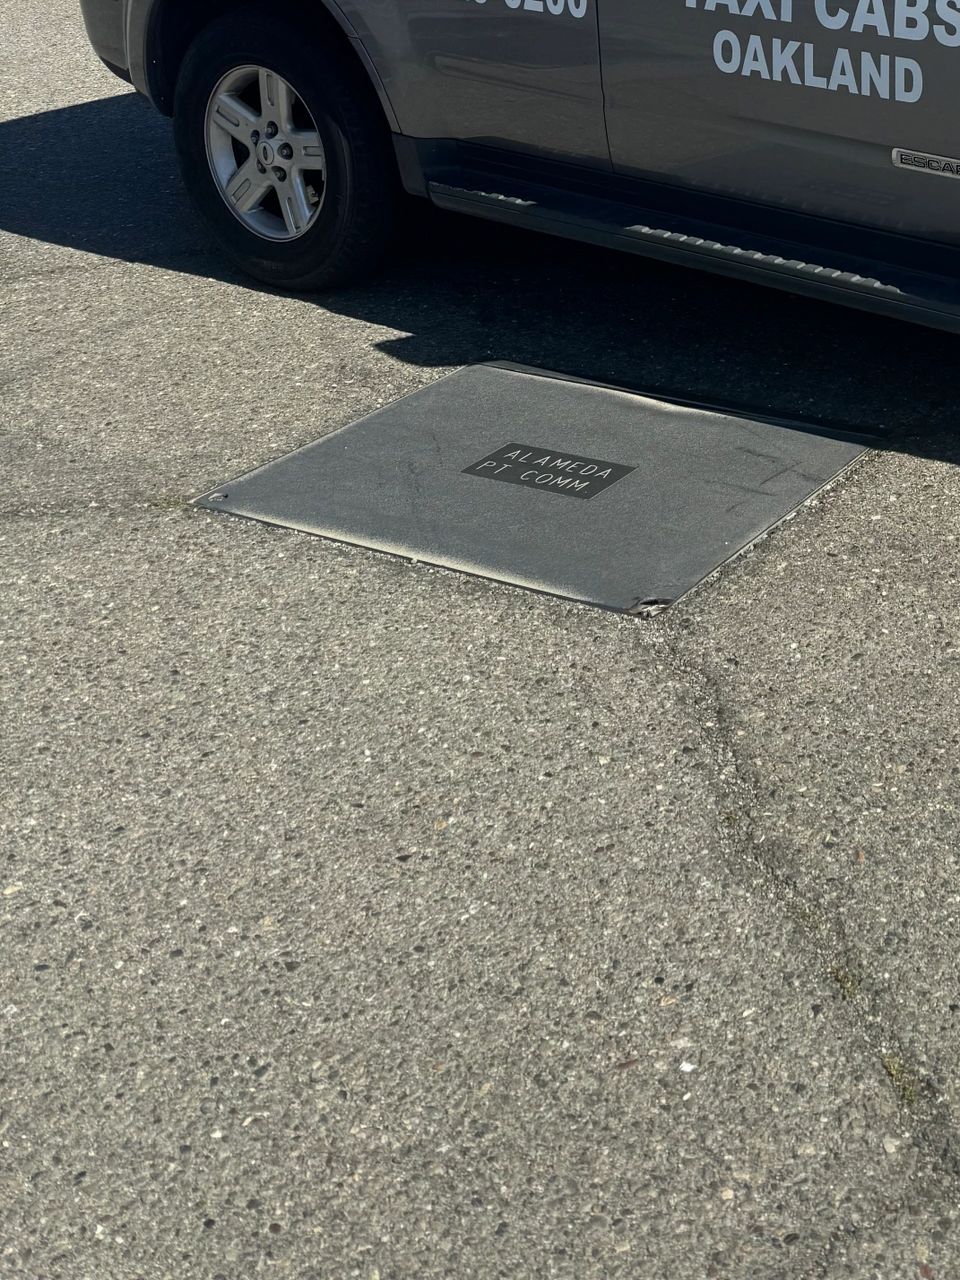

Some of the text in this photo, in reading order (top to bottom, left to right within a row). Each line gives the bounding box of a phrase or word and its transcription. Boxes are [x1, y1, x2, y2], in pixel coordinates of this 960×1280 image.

[713, 29, 924, 103] OAKLAND
[476, 460, 512, 475] PT
[503, 449, 613, 480] ALAMEDA
